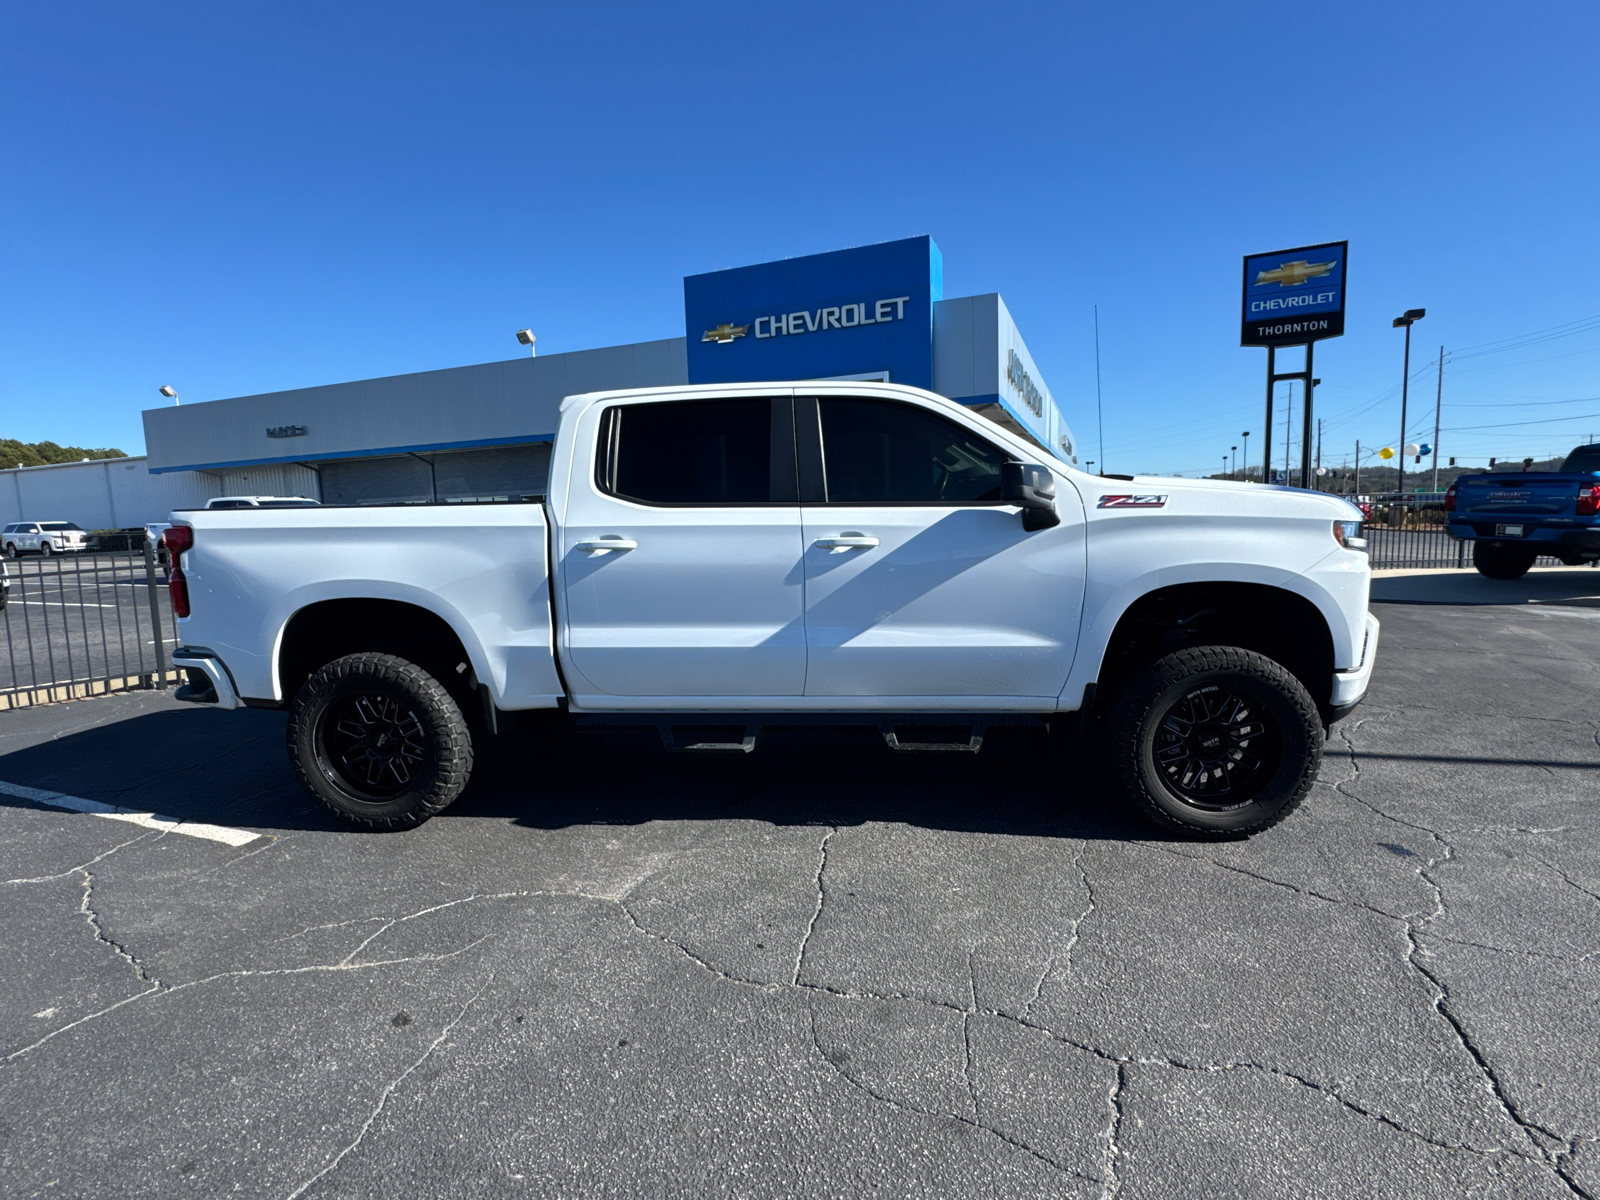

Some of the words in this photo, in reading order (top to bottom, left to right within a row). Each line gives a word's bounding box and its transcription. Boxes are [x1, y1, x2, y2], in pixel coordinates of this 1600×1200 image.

[1251, 291, 1336, 312] CHEVROLET
[754, 296, 910, 339] CHEVROLET
[1257, 319, 1328, 337] THORNTON
[1096, 494, 1168, 509] Z71
